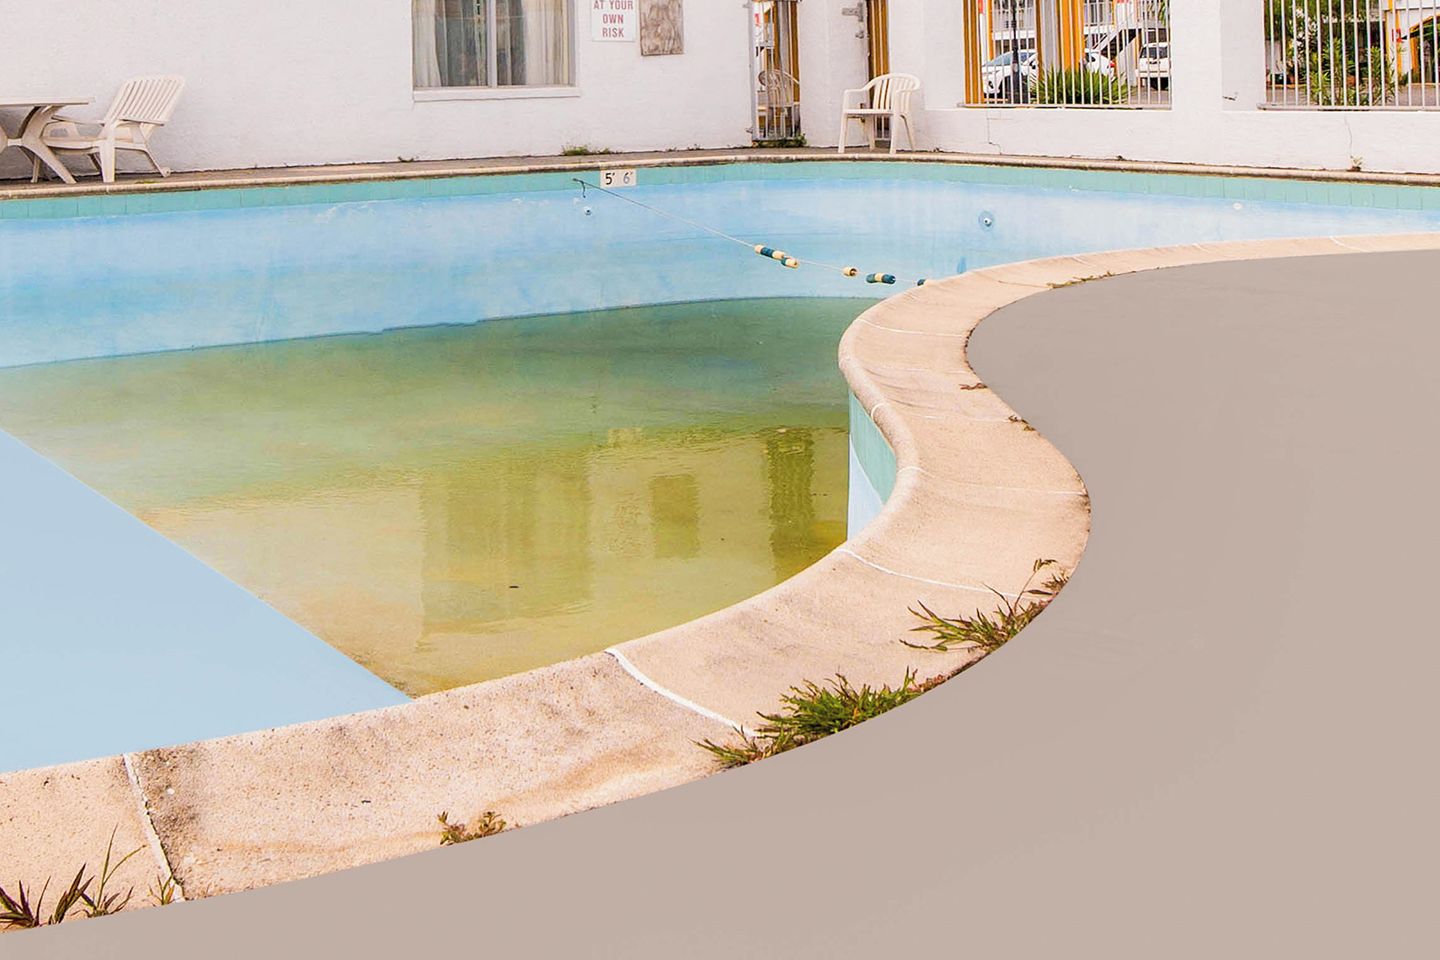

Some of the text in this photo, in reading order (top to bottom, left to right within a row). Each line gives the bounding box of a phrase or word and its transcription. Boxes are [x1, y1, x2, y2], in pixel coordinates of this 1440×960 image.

[593, 0, 633, 10] AT YOUR
[602, 14, 624, 24] OWN
[602, 28, 624, 38] RISK
